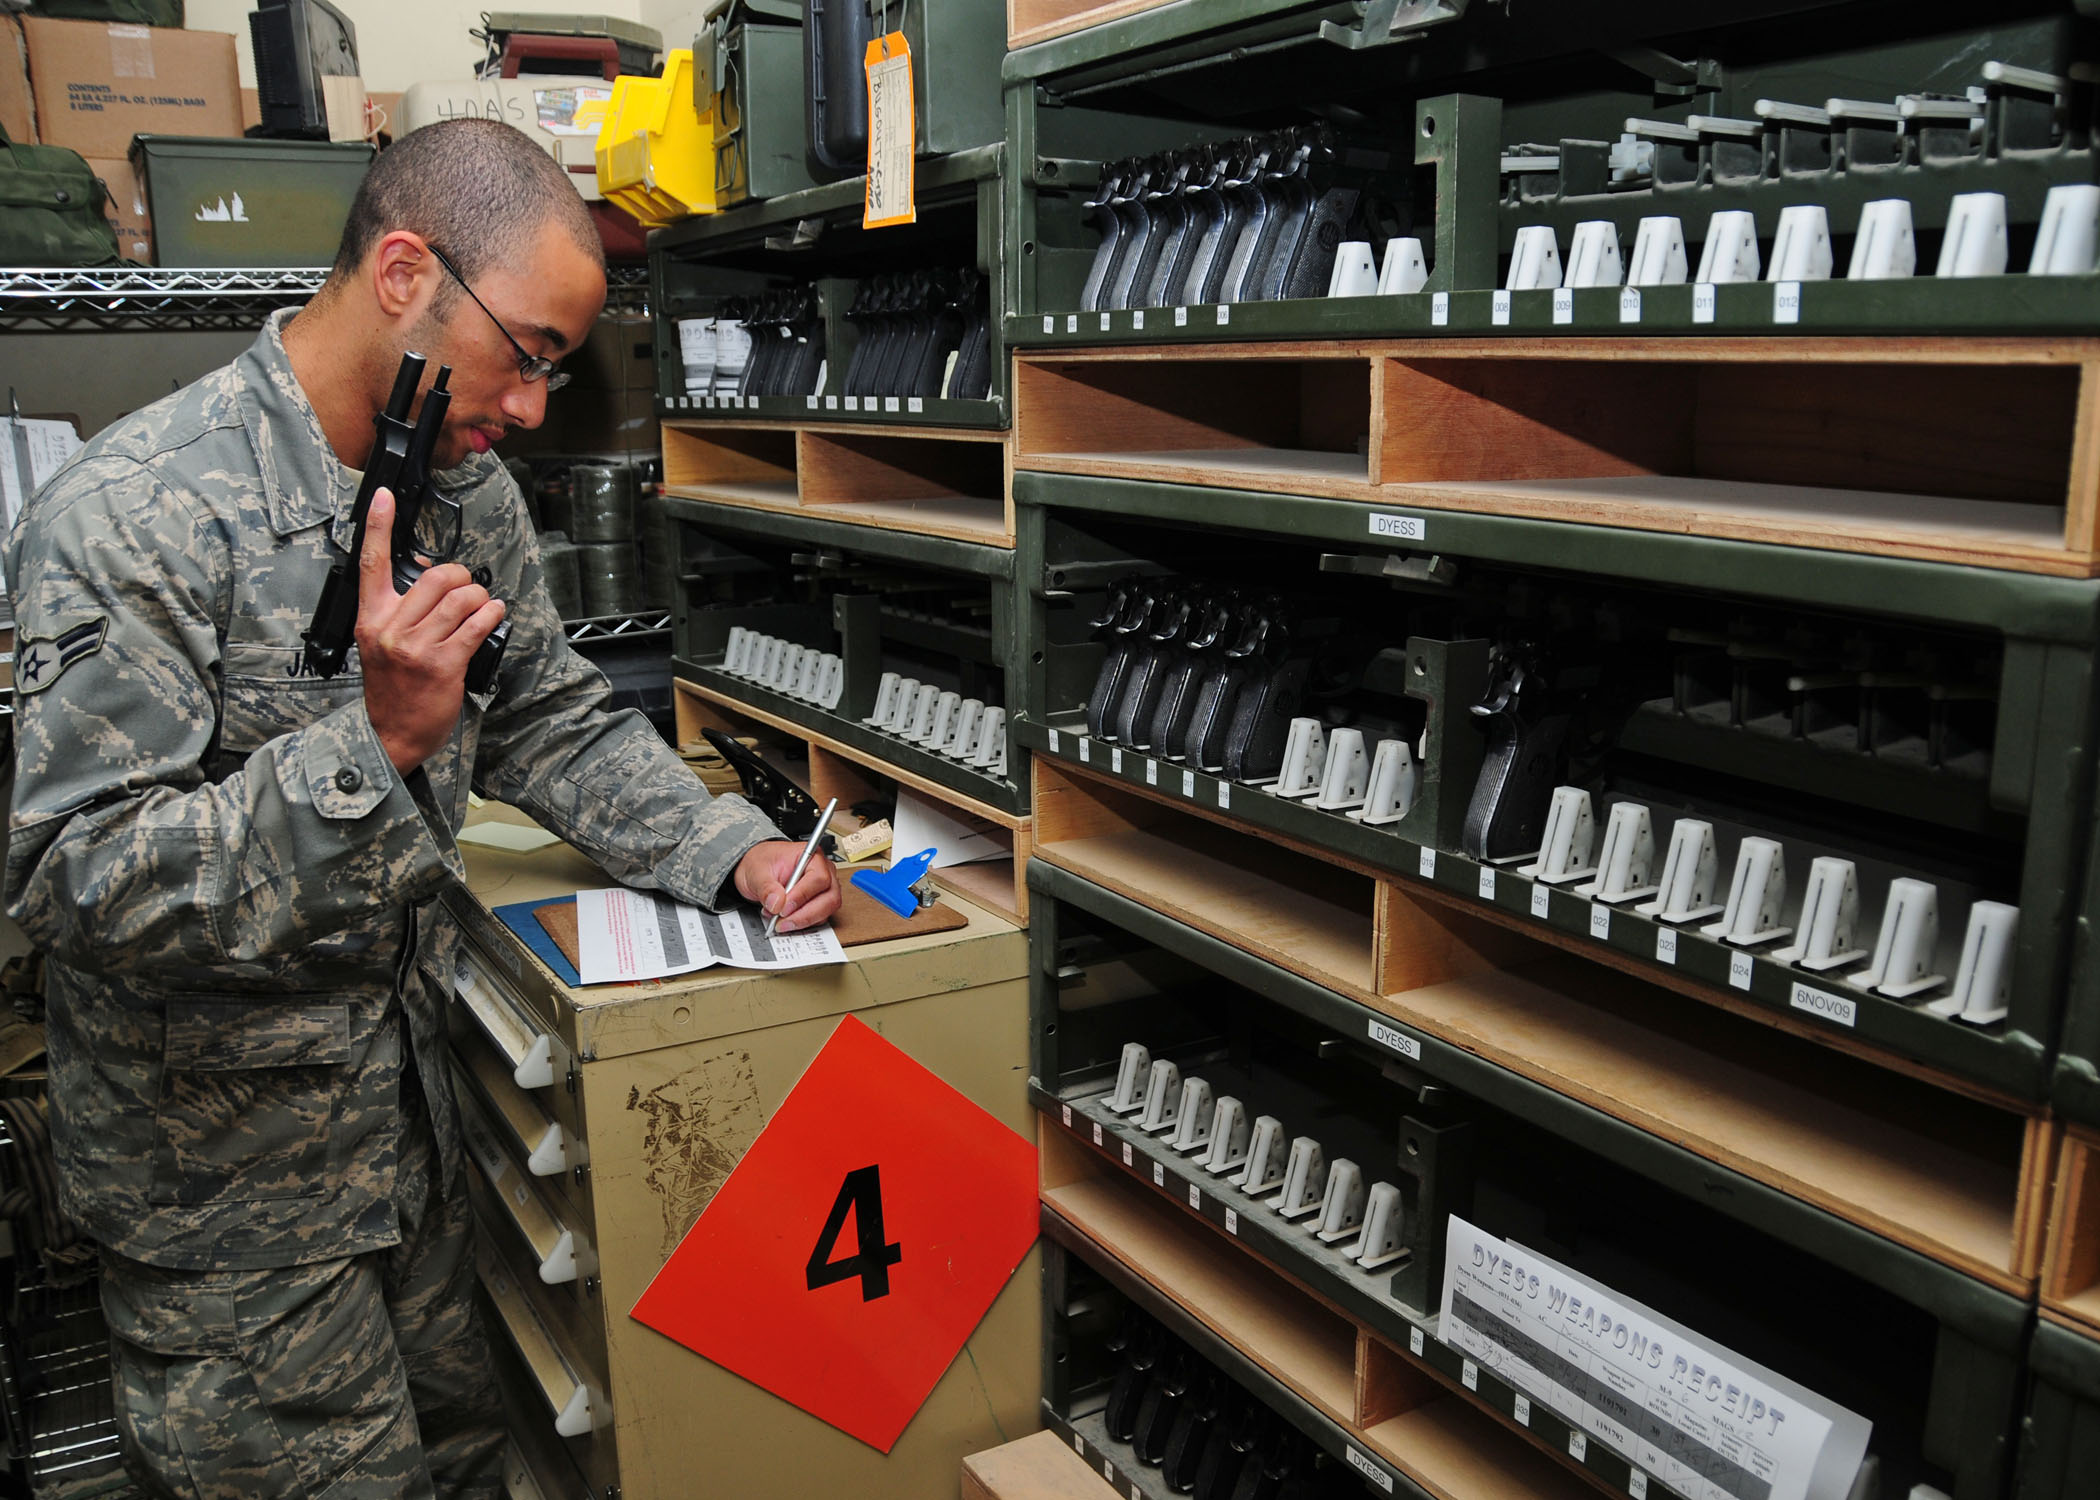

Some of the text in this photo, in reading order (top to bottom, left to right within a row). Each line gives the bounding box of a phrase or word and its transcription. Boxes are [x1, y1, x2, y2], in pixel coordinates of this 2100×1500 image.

[67, 84, 111, 92] CONTENTS
[78, 103, 104, 112] LITERS
[133, 96, 148, 105] OZ.
[1434, 304, 1446, 313] 007
[1495, 302, 1508, 312] 008
[1556, 300, 1571, 311] 009
[1622, 298, 1638, 309] 010
[1696, 298, 1713, 308] 011
[1778, 296, 1798, 308] 012
[1378, 518, 1416, 536] DYESS
[1184, 778, 1193, 789] 017
[1421, 857, 1434, 868] 019
[1482, 878, 1494, 888] 020
[1533, 894, 1547, 906] 021
[1593, 915, 1608, 928] 022
[1659, 938, 1675, 952] 023
[1732, 963, 1750, 977] 024
[1796, 989, 1850, 1019] 6NOV09
[1376, 1026, 1412, 1054] DYESS
[806, 1164, 902, 1303] 4
[1412, 1336, 1422, 1347] 031
[1472, 1243, 1540, 1300] DYESS
[1547, 1284, 1664, 1368] WEAPONS
[1668, 1354, 1786, 1437] RECEIPT
[1464, 1368, 1476, 1382] 032
[1608, 1376, 1626, 1391] Number
[1516, 1402, 1528, 1417] 033
[1648, 1402, 1672, 1418] ROUNDS
[1712, 1415, 1735, 1433] MAGS
[1570, 1438, 1584, 1452] 034
[1596, 1420, 1624, 1444] 1191792
[1648, 1453, 1656, 1464] 30
[1354, 1453, 1386, 1486] DYESS
[1631, 1478, 1646, 1493] 035
